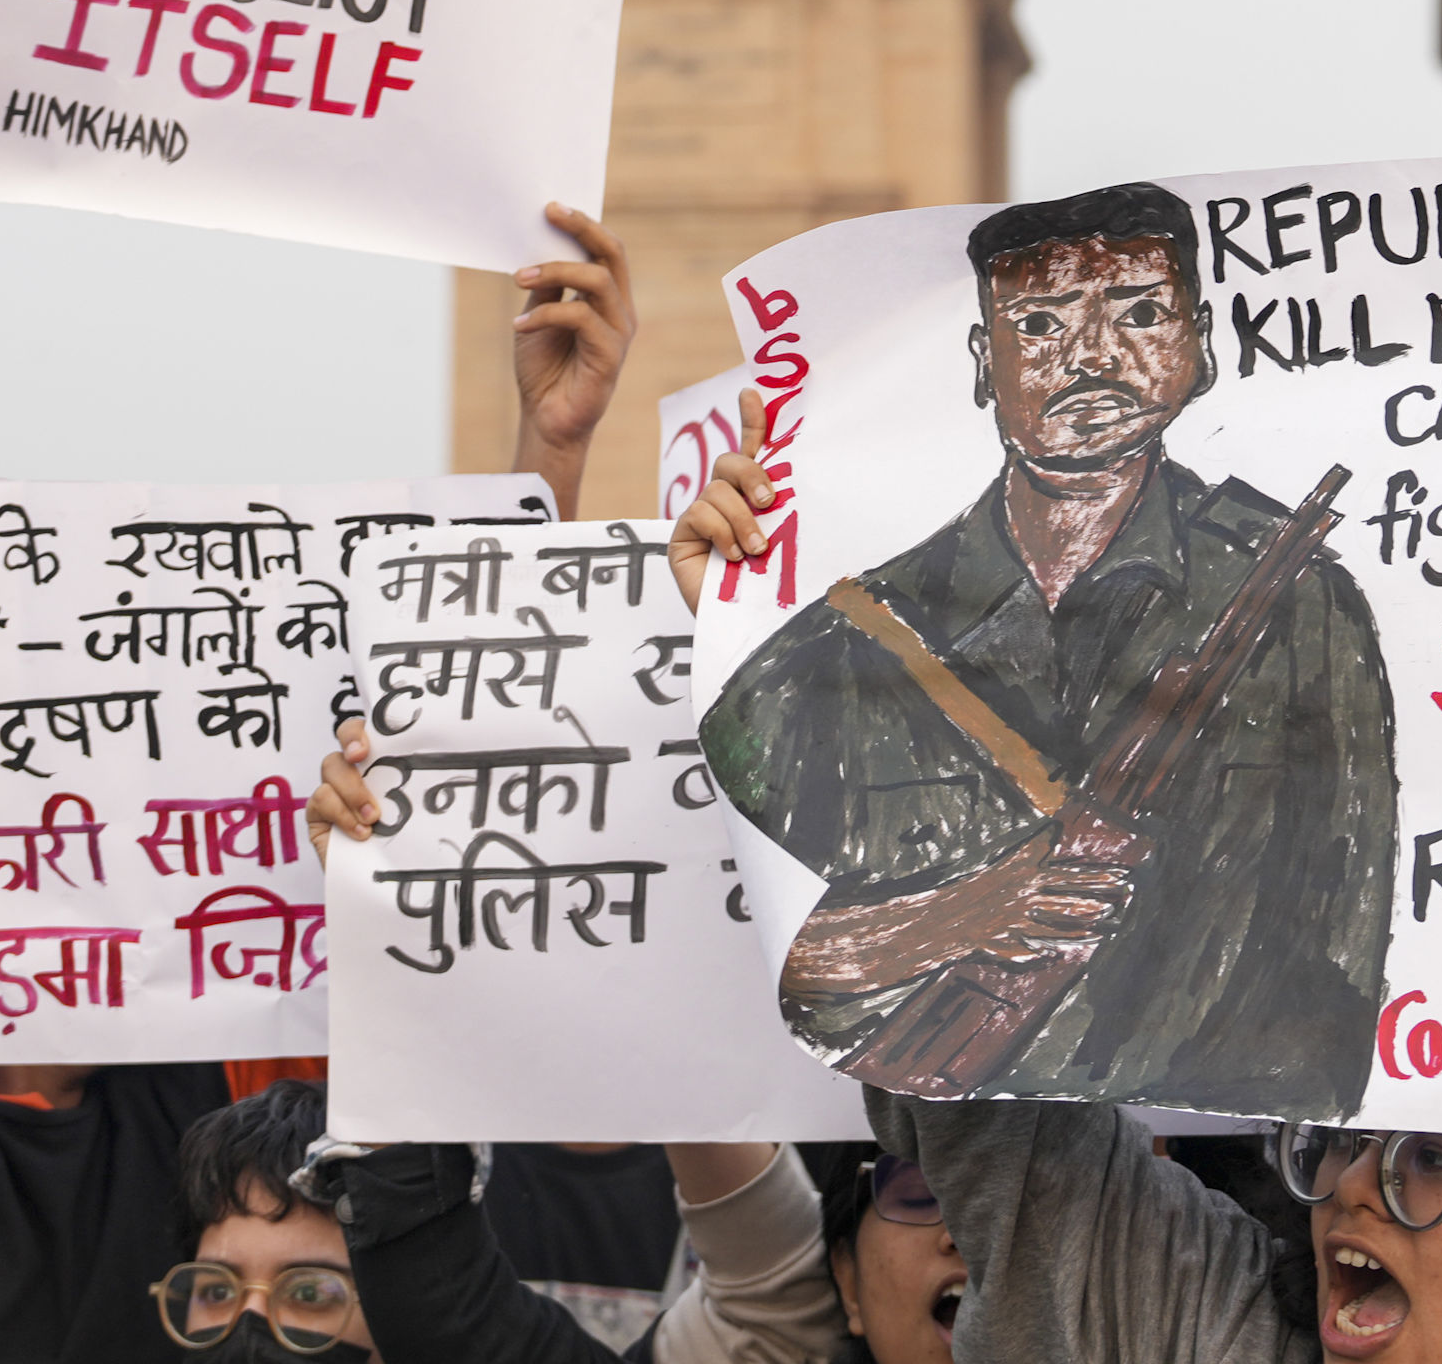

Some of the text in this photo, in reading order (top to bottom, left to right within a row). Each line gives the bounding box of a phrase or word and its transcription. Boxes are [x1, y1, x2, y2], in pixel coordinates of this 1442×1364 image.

[2, 90, 188, 164] HIMKHAND
[1232, 292, 1412, 377] KILL
[105, 502, 314, 580] रखवाले
[378, 536, 514, 623] मंत्री
[78, 587, 266, 667] जंगलों
[369, 605, 591, 737] हमसे
[361, 705, 631, 838] उनको
[136, 775, 310, 877] साथी
[372, 829, 668, 975] पुलिस
